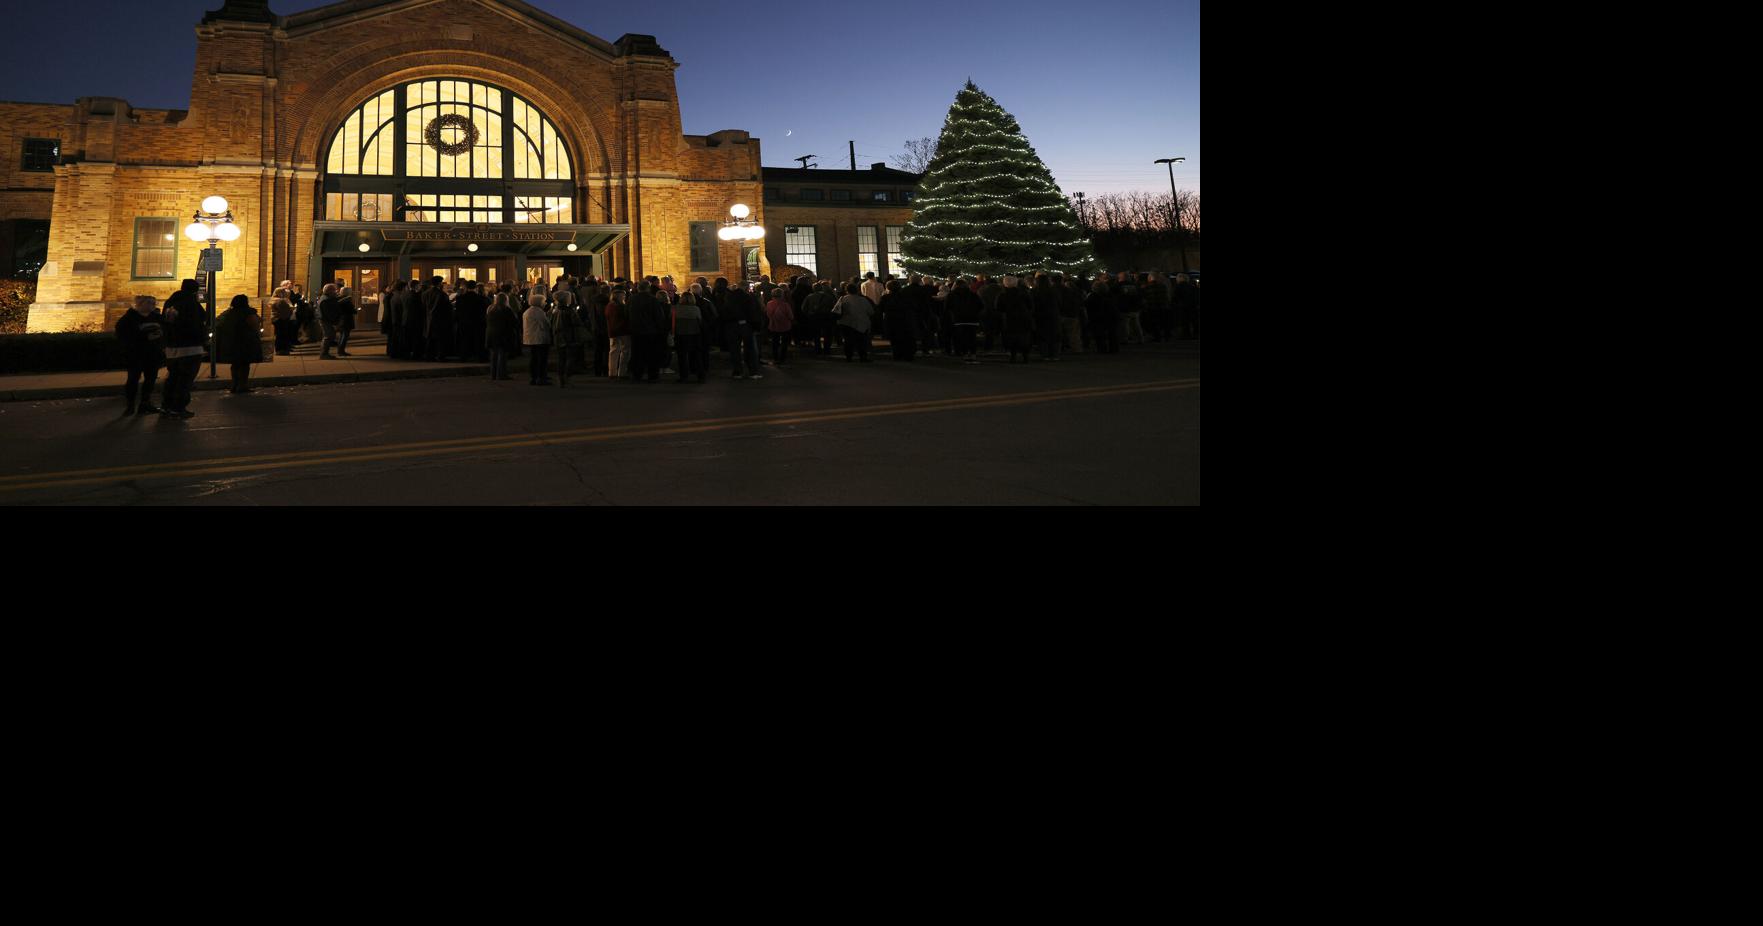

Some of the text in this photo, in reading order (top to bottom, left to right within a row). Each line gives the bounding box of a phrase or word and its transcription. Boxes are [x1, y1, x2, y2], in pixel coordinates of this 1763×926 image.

[407, 231, 554, 240] BAKER STREET STATION
